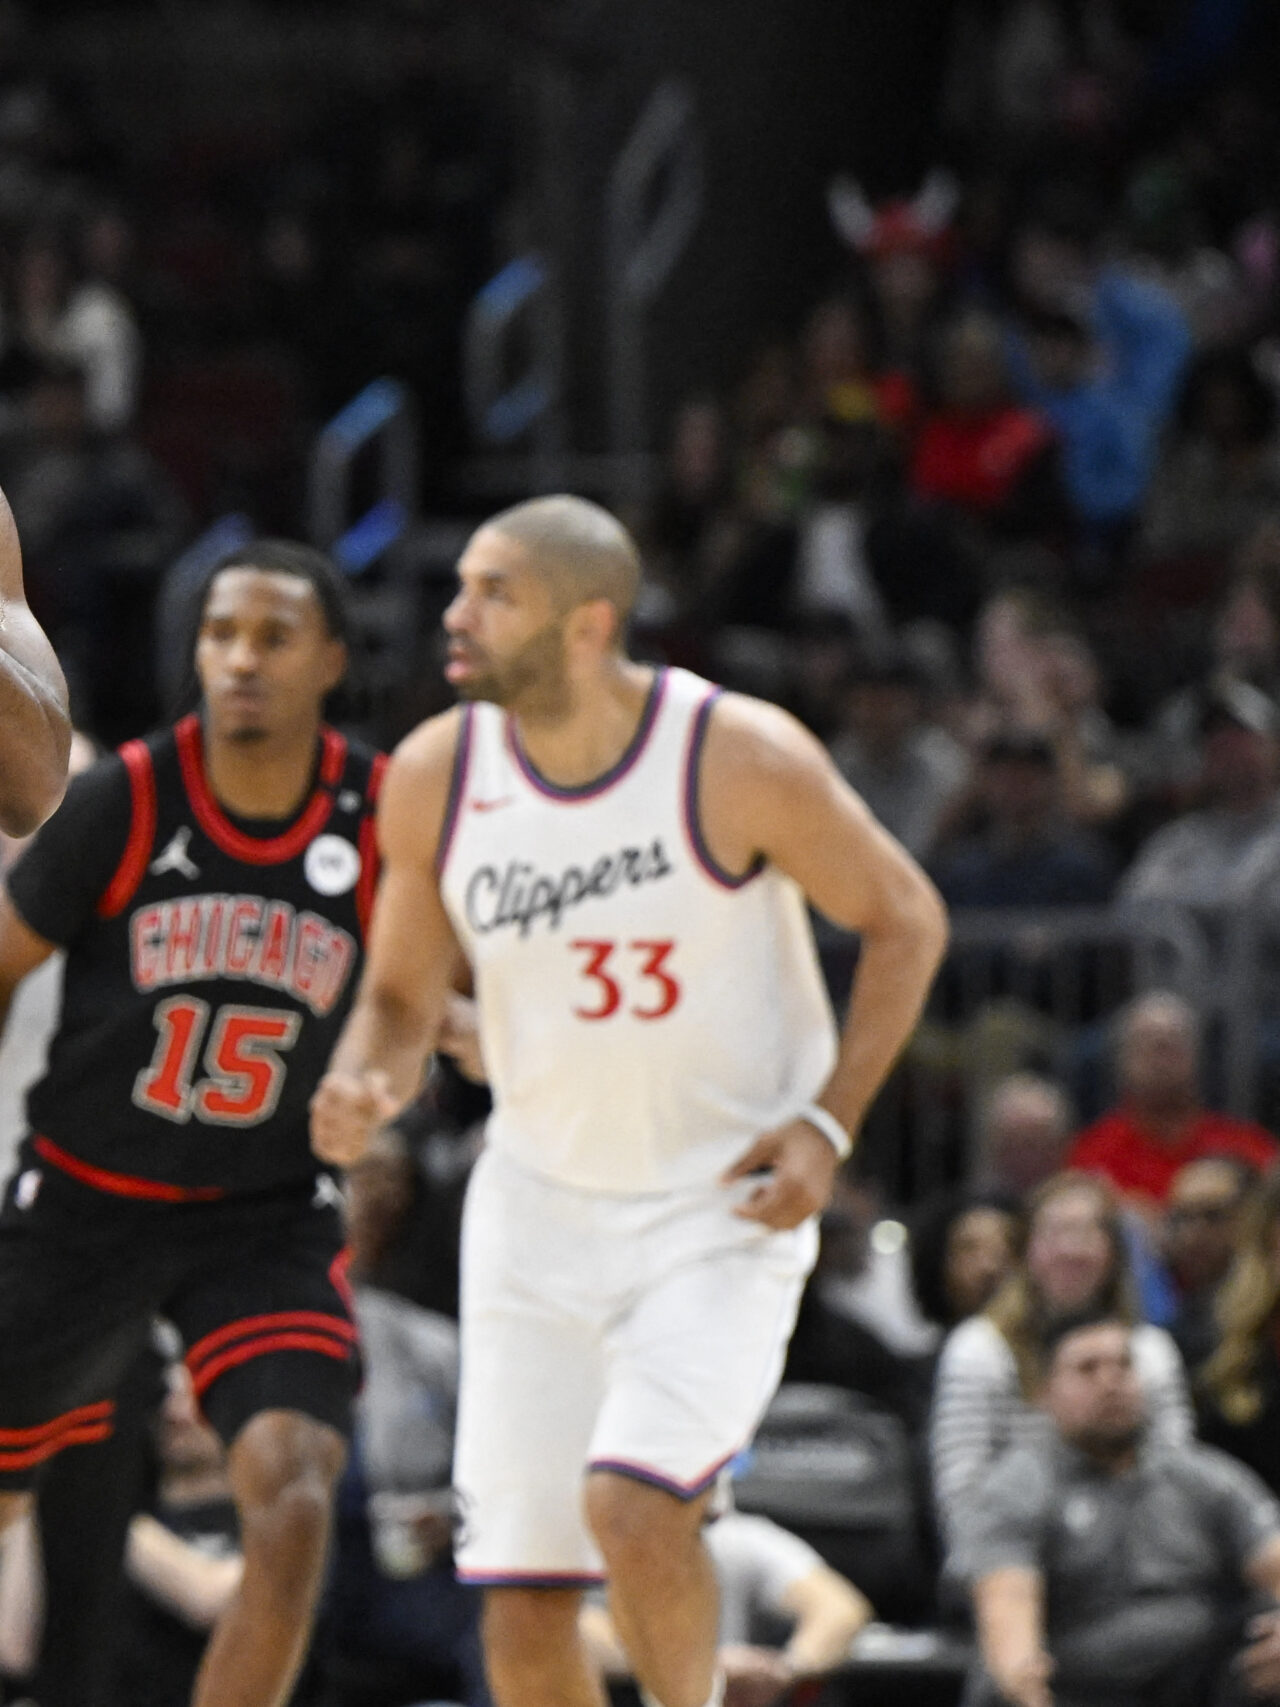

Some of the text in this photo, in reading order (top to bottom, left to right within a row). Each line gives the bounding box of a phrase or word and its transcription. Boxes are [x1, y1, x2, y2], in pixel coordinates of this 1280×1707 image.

[465, 838, 674, 937] Clippers
[129, 892, 358, 1019] CHICAGO
[568, 936, 684, 1022] 33
[131, 994, 304, 1128] 15
